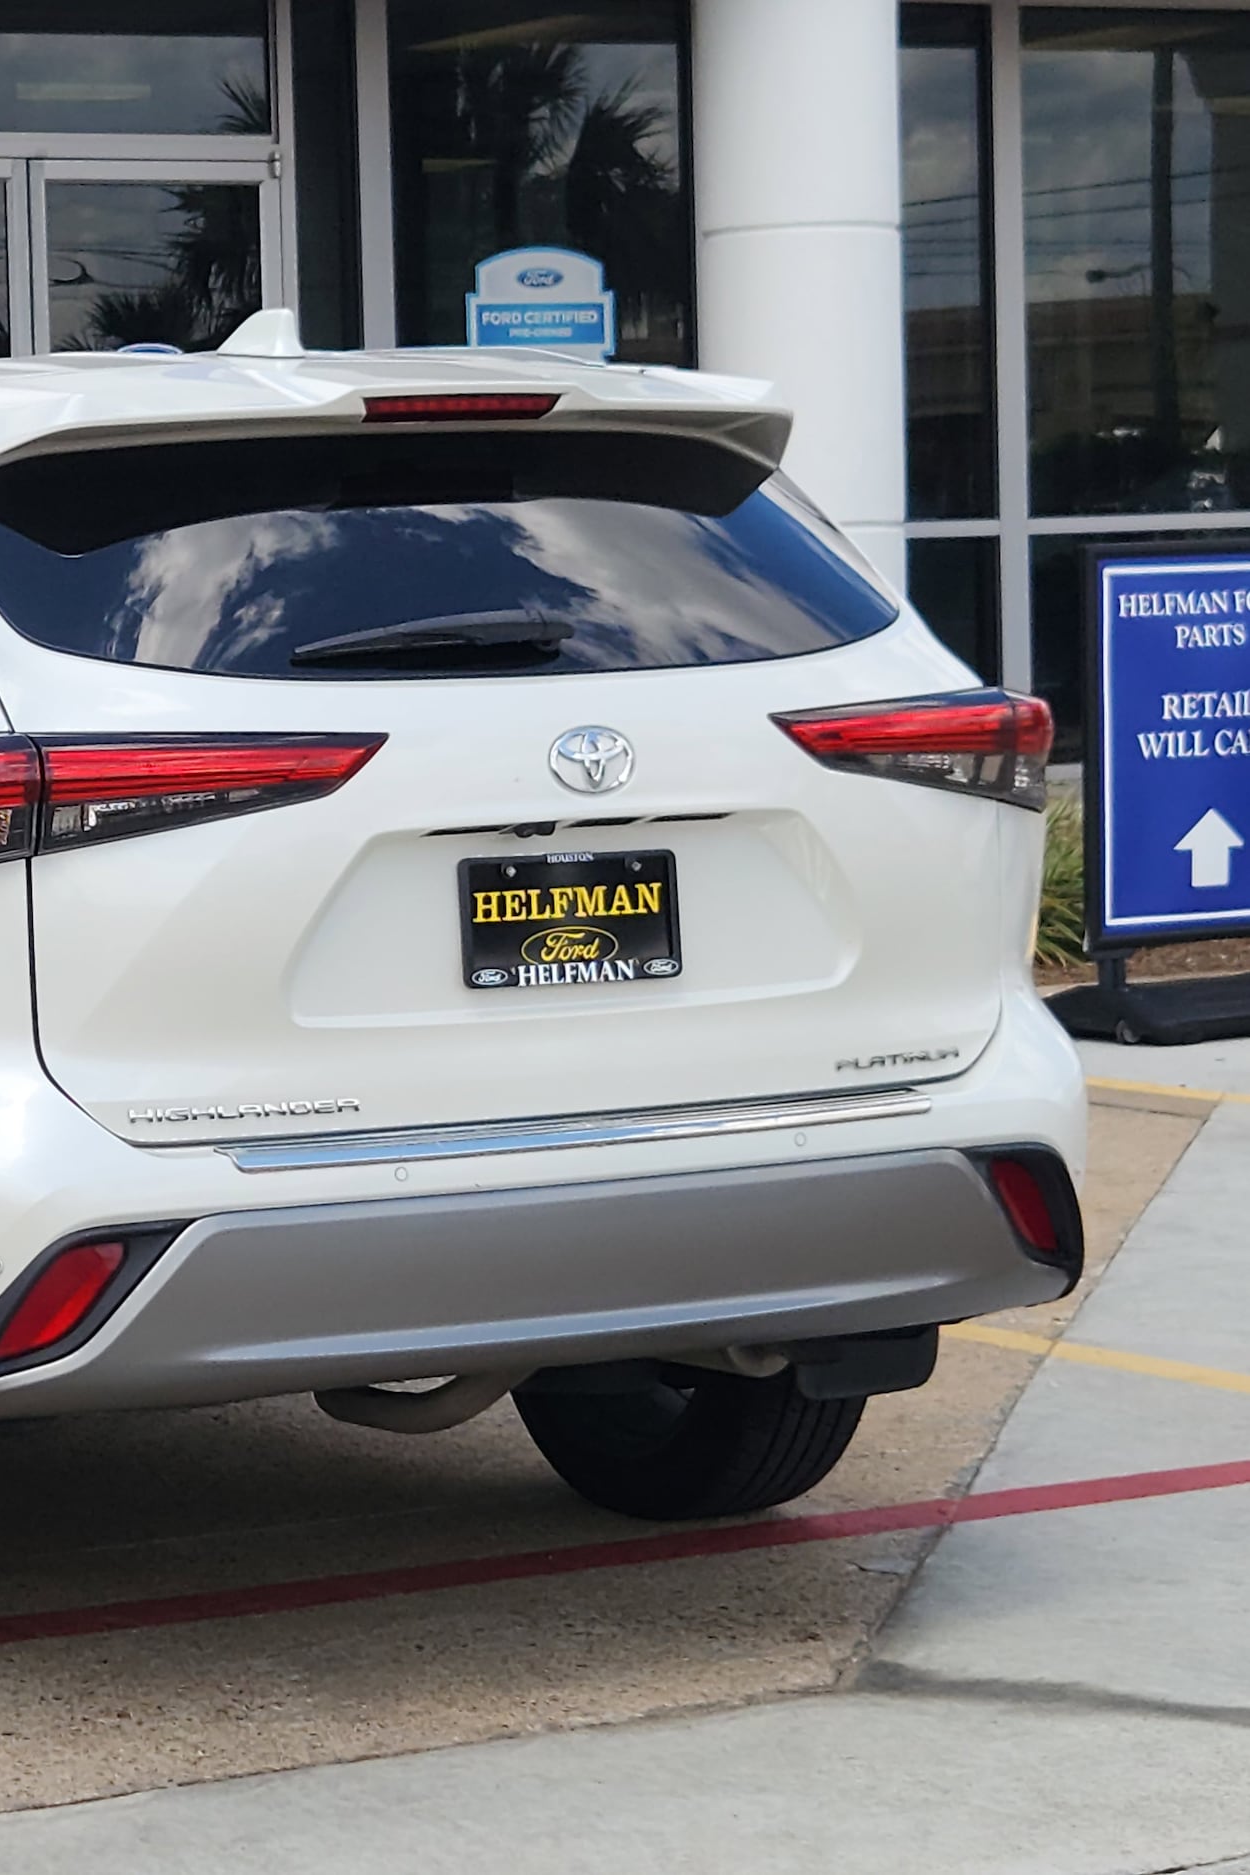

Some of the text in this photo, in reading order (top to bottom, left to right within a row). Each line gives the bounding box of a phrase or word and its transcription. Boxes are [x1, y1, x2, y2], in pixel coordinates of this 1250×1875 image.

[481, 310, 598, 325] FORD CERTIFIED
[1118, 590, 1250, 617] HELFMAN F
[1174, 623, 1245, 648] PARTS
[1136, 729, 1250, 760] WILL CA
[547, 852, 594, 864] HOUSTON
[473, 882, 662, 923] HELFMAN
[541, 932, 599, 961] Ford
[128, 1097, 361, 1124] HIGHLANDER
